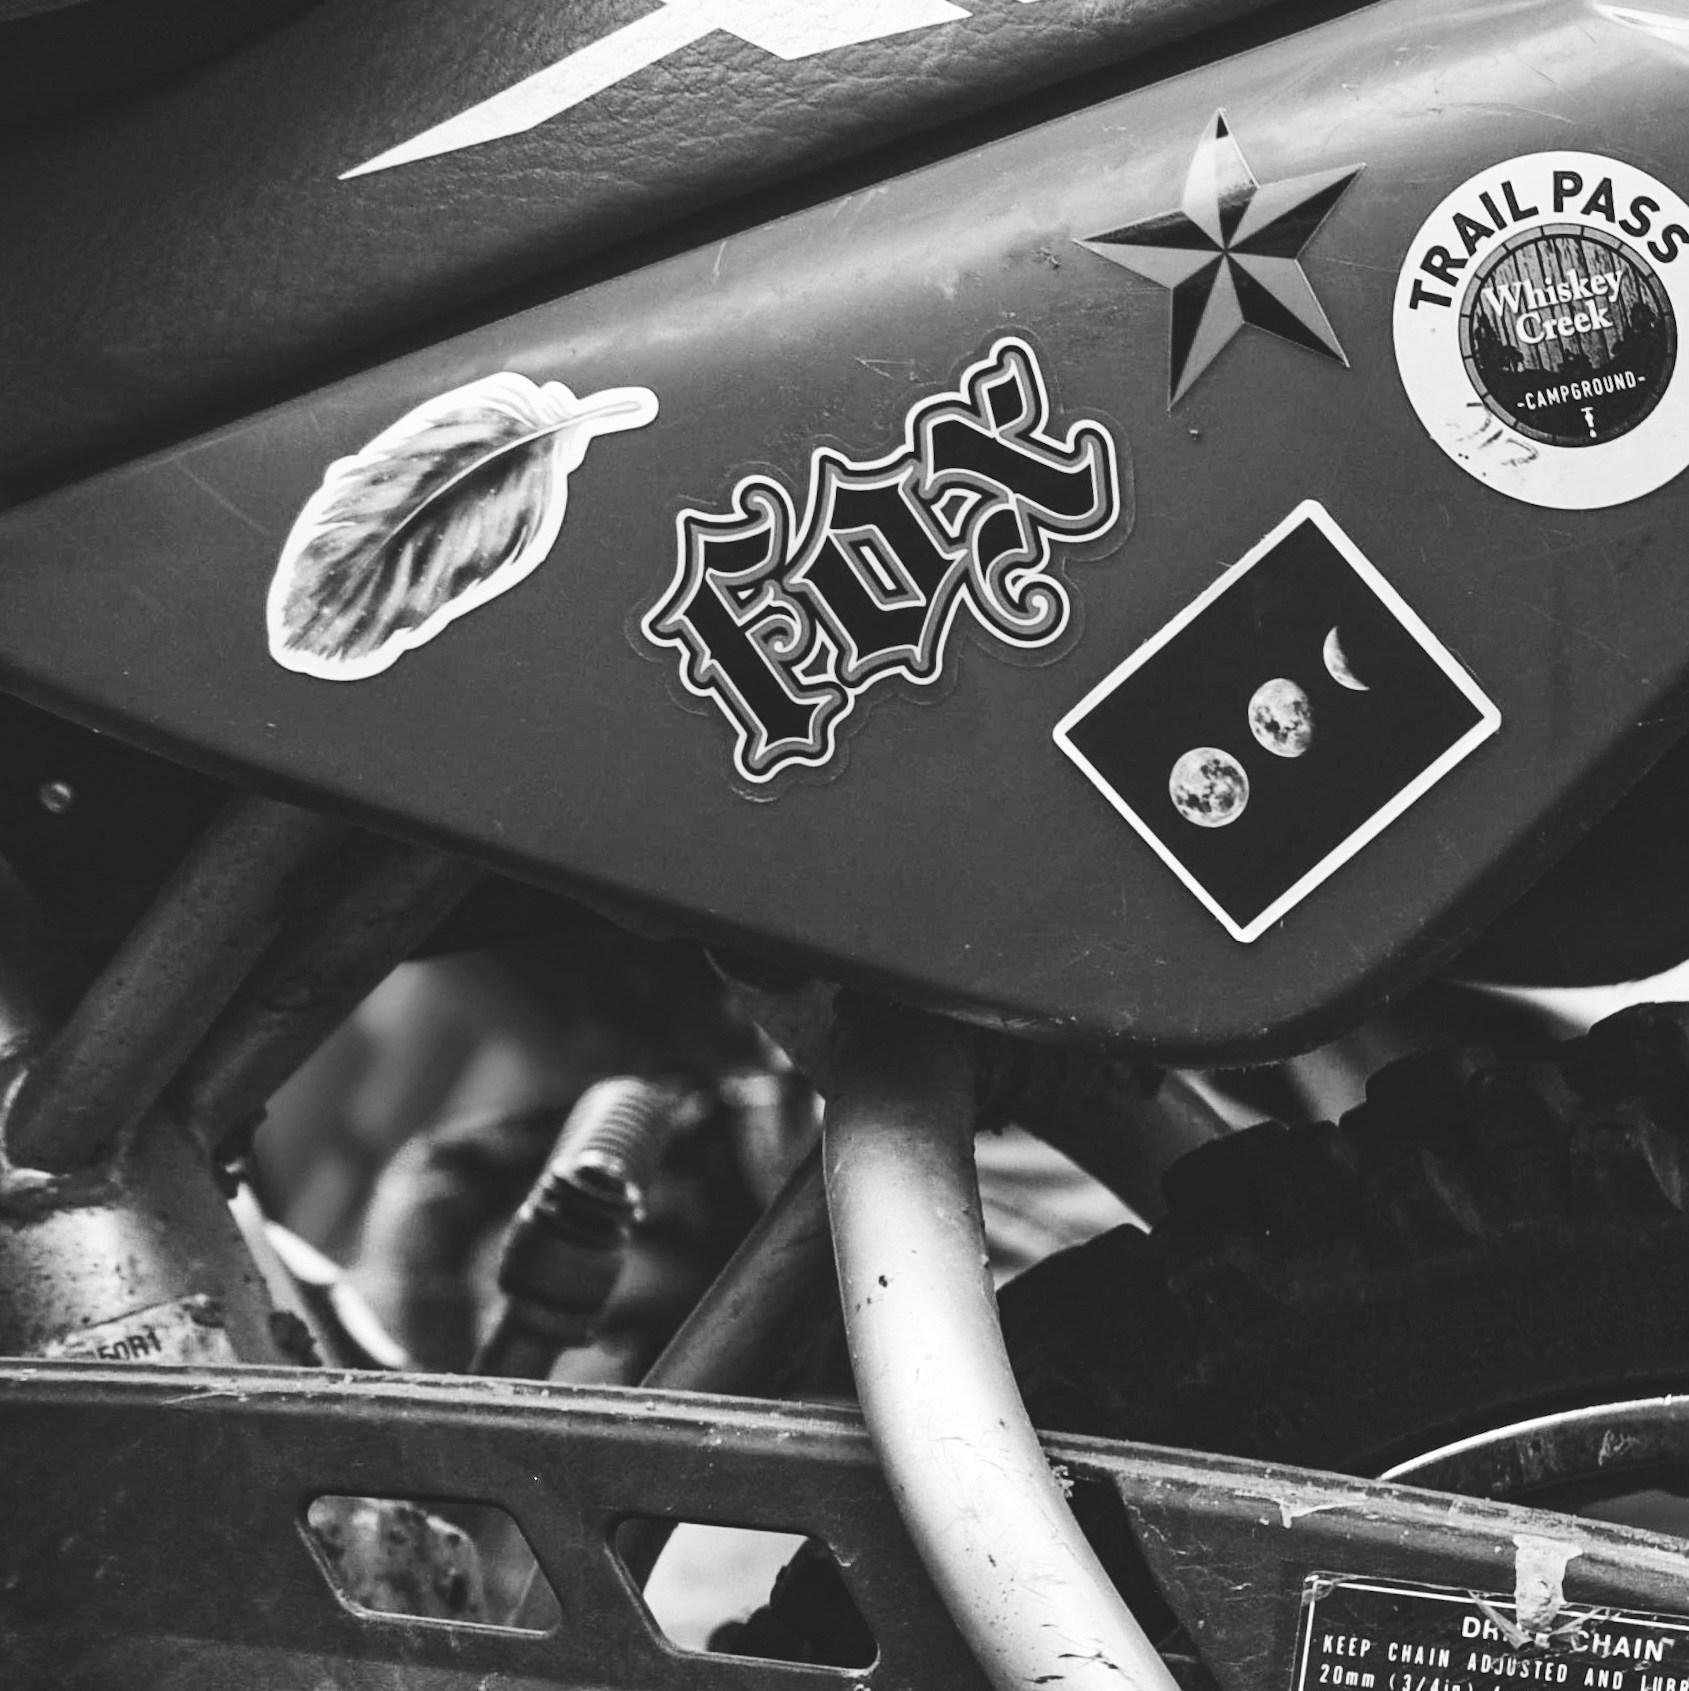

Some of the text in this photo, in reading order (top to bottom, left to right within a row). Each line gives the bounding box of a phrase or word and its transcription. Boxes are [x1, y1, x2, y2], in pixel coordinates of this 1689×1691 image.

[1408, 179, 1540, 311] TRAIL
[1480, 267, 1625, 319] Whiskey
[1514, 303, 1614, 346] Creek
[1321, 1633, 1372, 1659] KEEP
[1386, 1641, 1451, 1669] CHAIN
[1466, 1651, 1569, 1684] ADJUSTED
[1583, 1666, 1625, 1691] AND
[1570, 1630, 1667, 1663] CHAIN
[1318, 1663, 1376, 1689] 20mm
